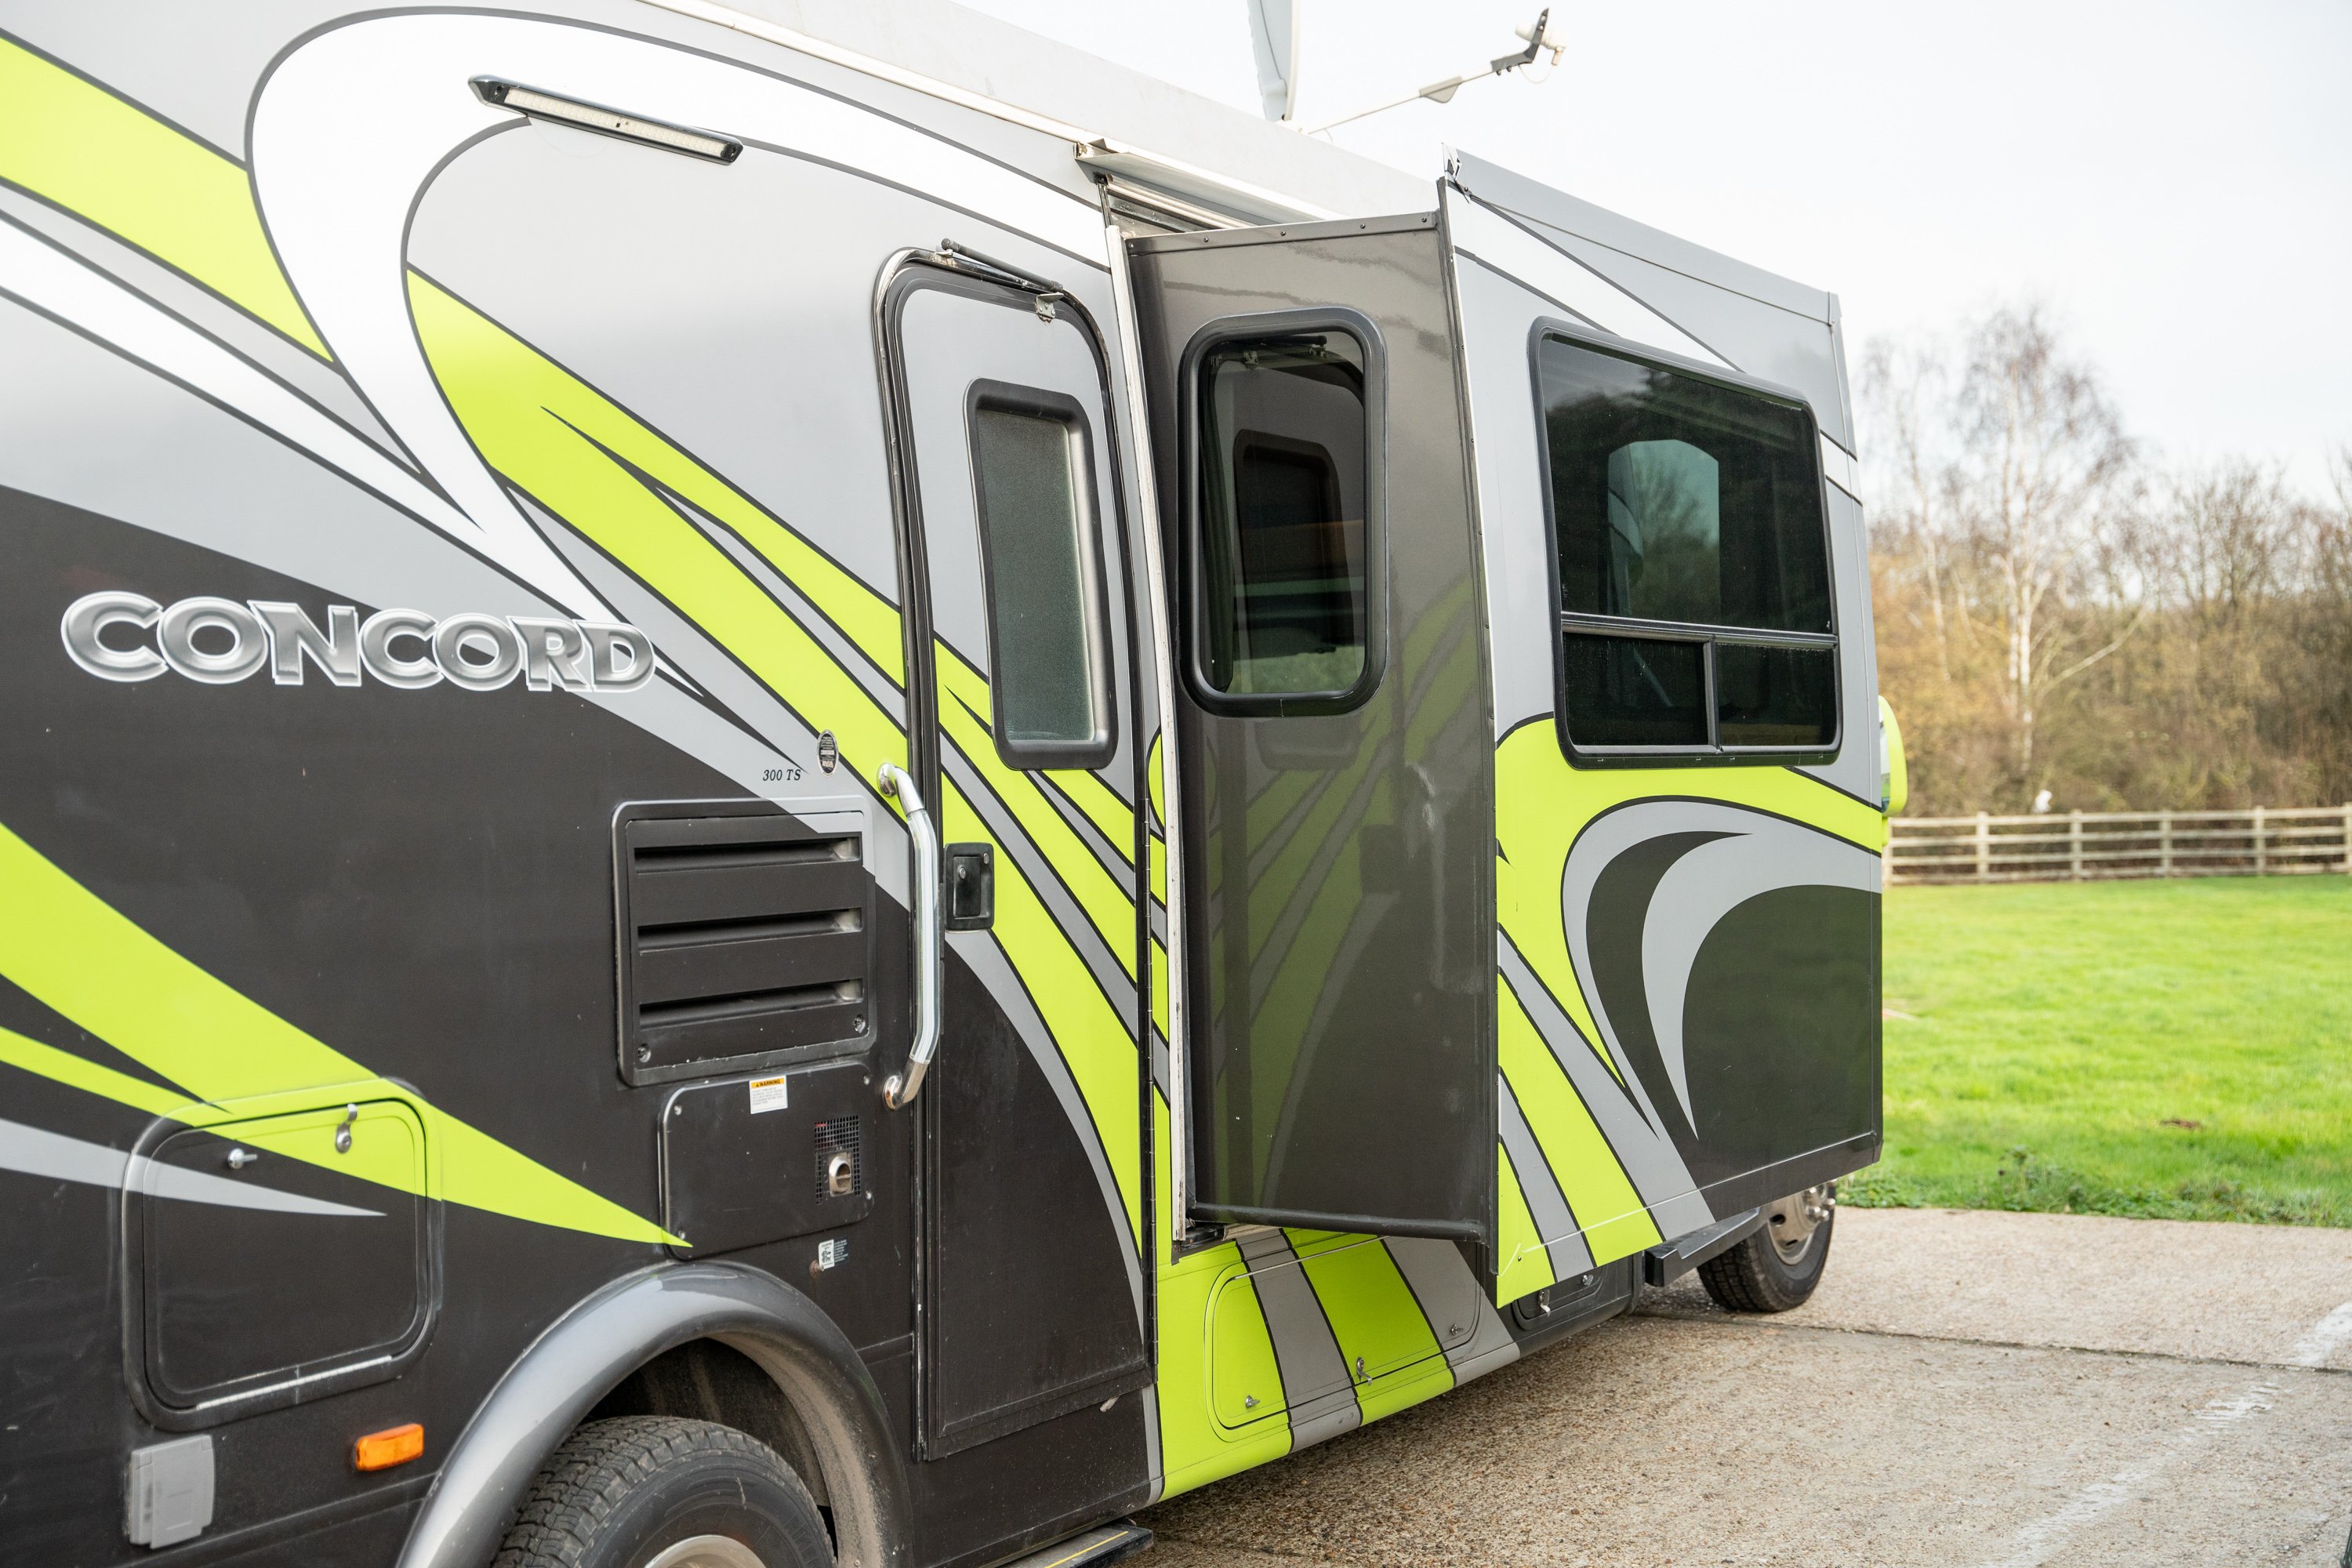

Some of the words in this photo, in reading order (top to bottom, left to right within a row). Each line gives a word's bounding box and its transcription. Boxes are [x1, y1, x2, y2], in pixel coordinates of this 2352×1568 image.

[60, 590, 656, 693] CONCORD
[762, 769, 782, 782] 300
[786, 768, 801, 781] TS
